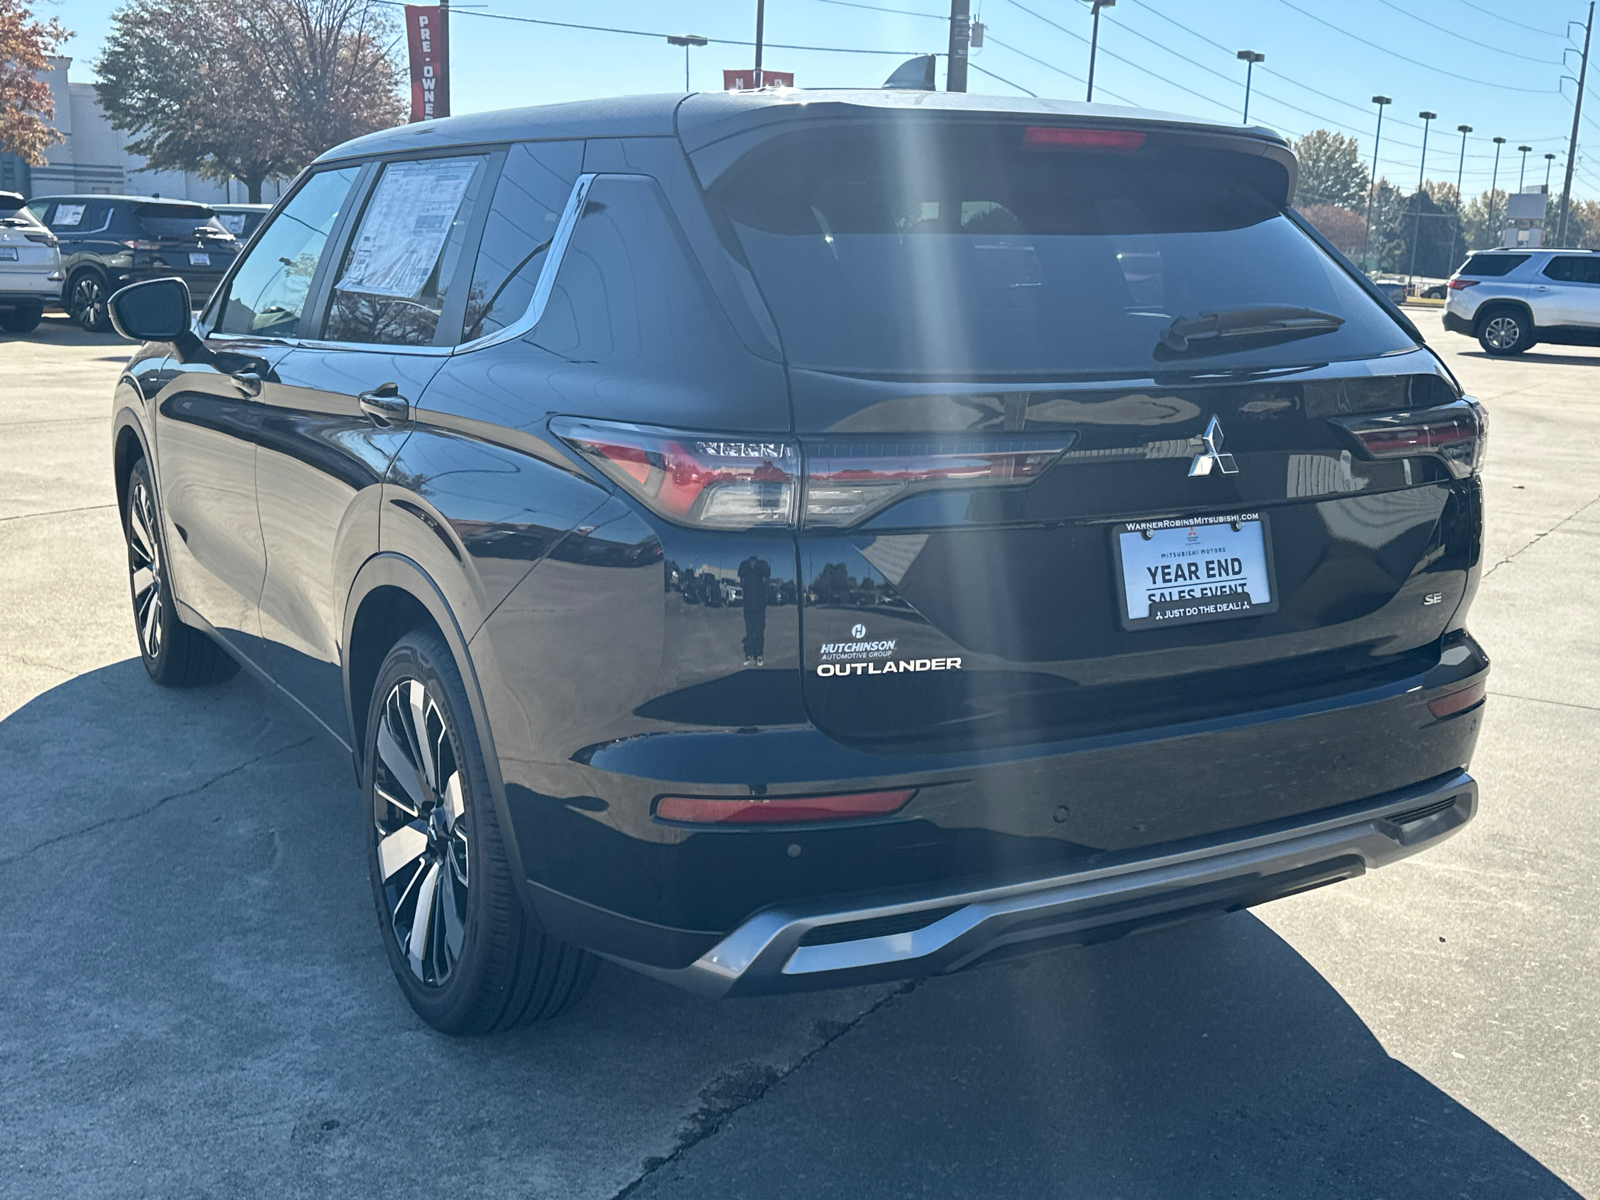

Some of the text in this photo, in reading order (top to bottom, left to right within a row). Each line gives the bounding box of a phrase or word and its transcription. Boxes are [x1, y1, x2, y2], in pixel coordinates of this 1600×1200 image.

[1161, 547, 1226, 559] MITSUBISHI MOTORS
[1147, 557, 1243, 584] YEAR END
[1148, 583, 1247, 604] SALES EVENT
[1423, 592, 1442, 606] SE
[1164, 601, 1242, 619] JUST DO THE DEAL!
[820, 640, 896, 654] HUTCHINSON
[822, 650, 893, 661] AUTOMOTIVE GROUP
[816, 657, 962, 677] OUTLANDER
